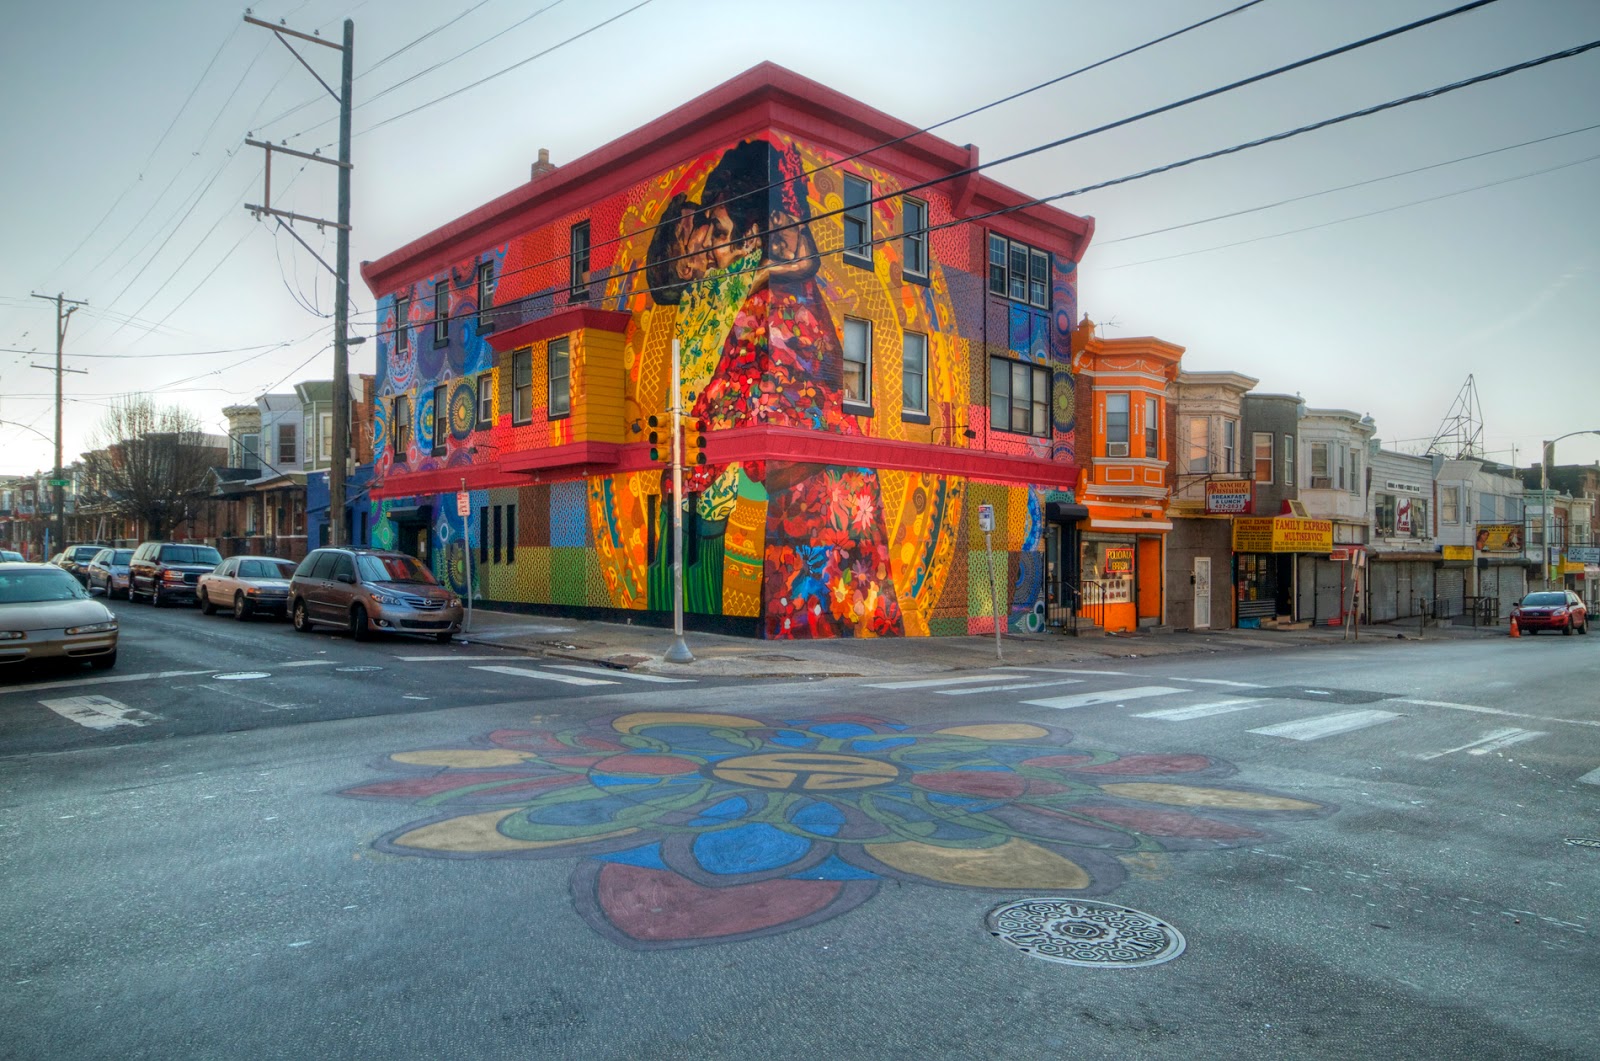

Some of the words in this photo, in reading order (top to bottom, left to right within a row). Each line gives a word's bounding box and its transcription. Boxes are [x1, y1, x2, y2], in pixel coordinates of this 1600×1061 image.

[1275, 520, 1300, 530] FAMILY
[1304, 521, 1330, 532] EXPRESS
[1284, 532, 1324, 542] MULTISERVICE
